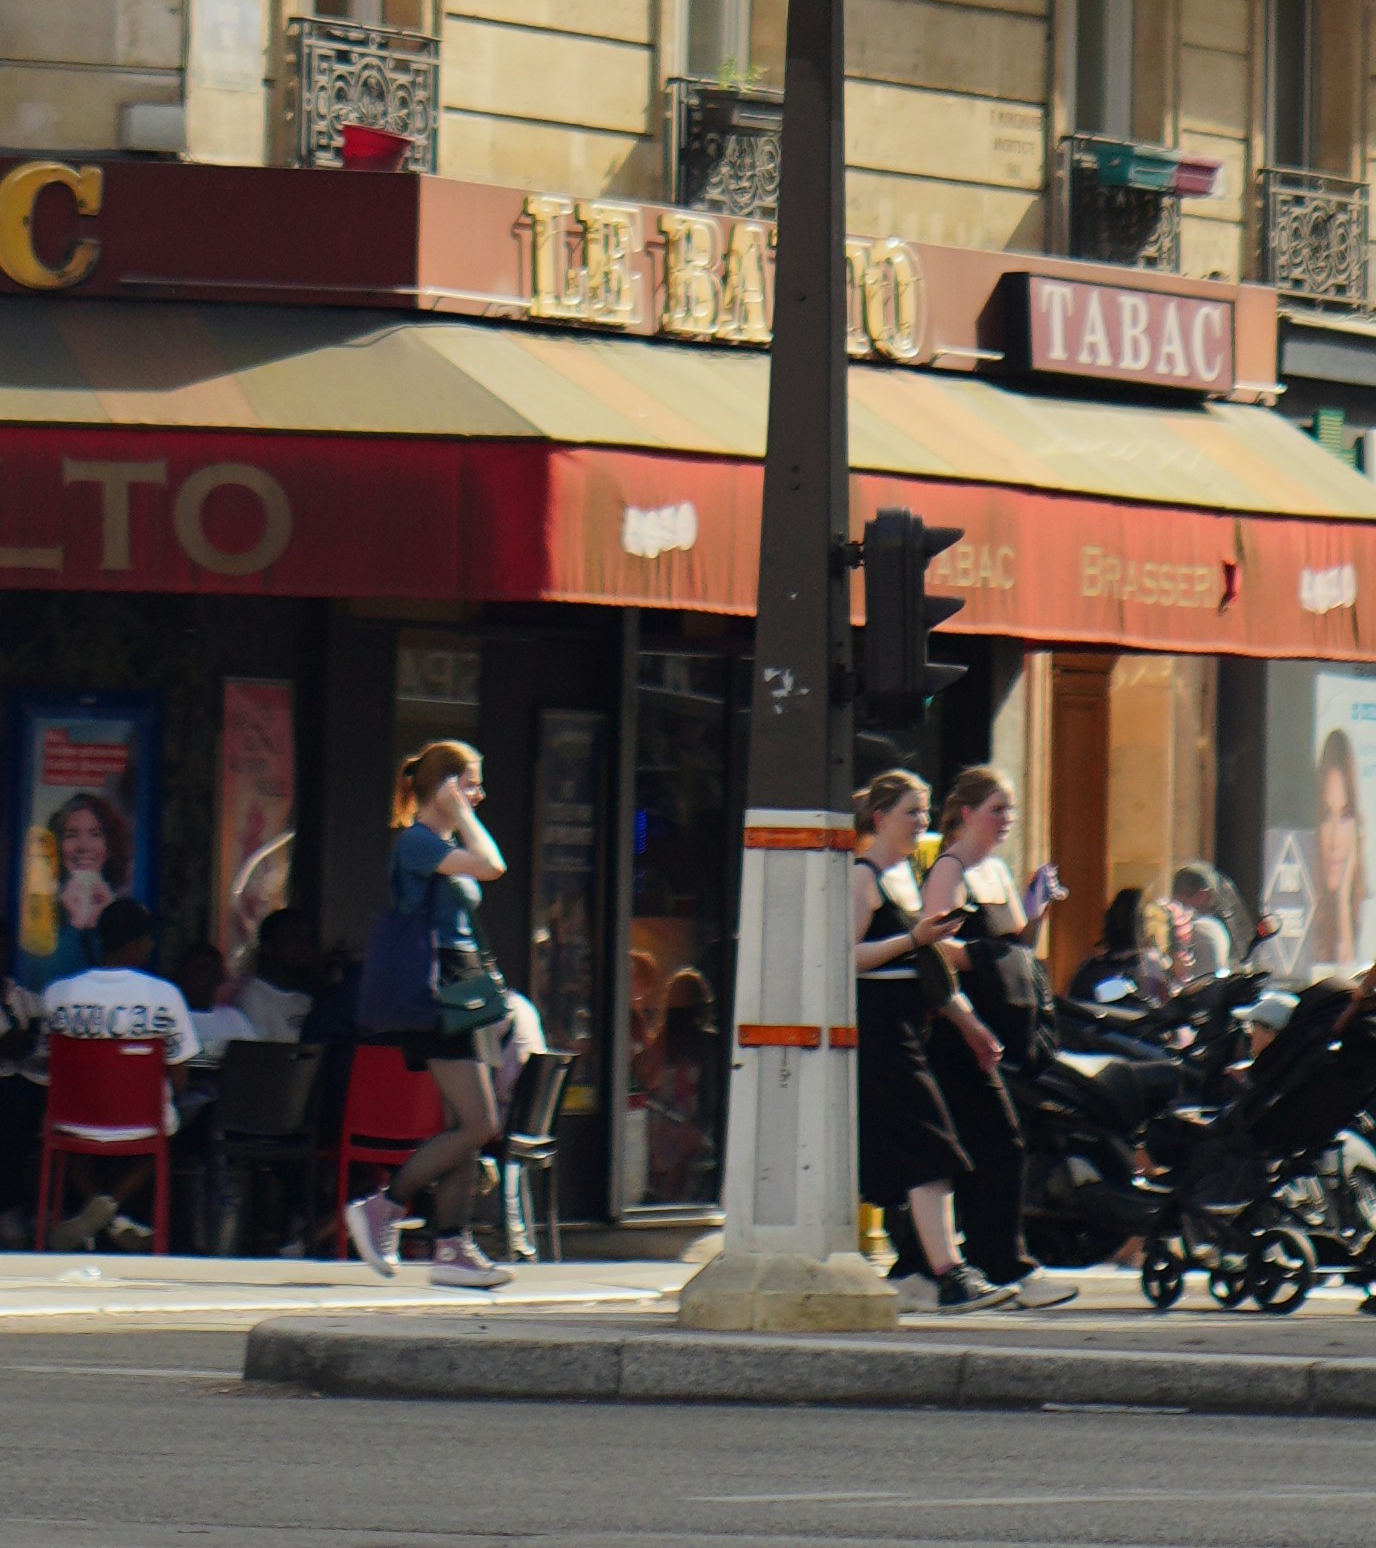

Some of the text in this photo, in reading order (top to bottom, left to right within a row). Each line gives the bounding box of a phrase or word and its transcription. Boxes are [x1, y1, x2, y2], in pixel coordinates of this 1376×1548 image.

[524, 193, 924, 358] LE BAO
[1041, 284, 1224, 383] TABAC
[926, 545, 1016, 589] ABAC
